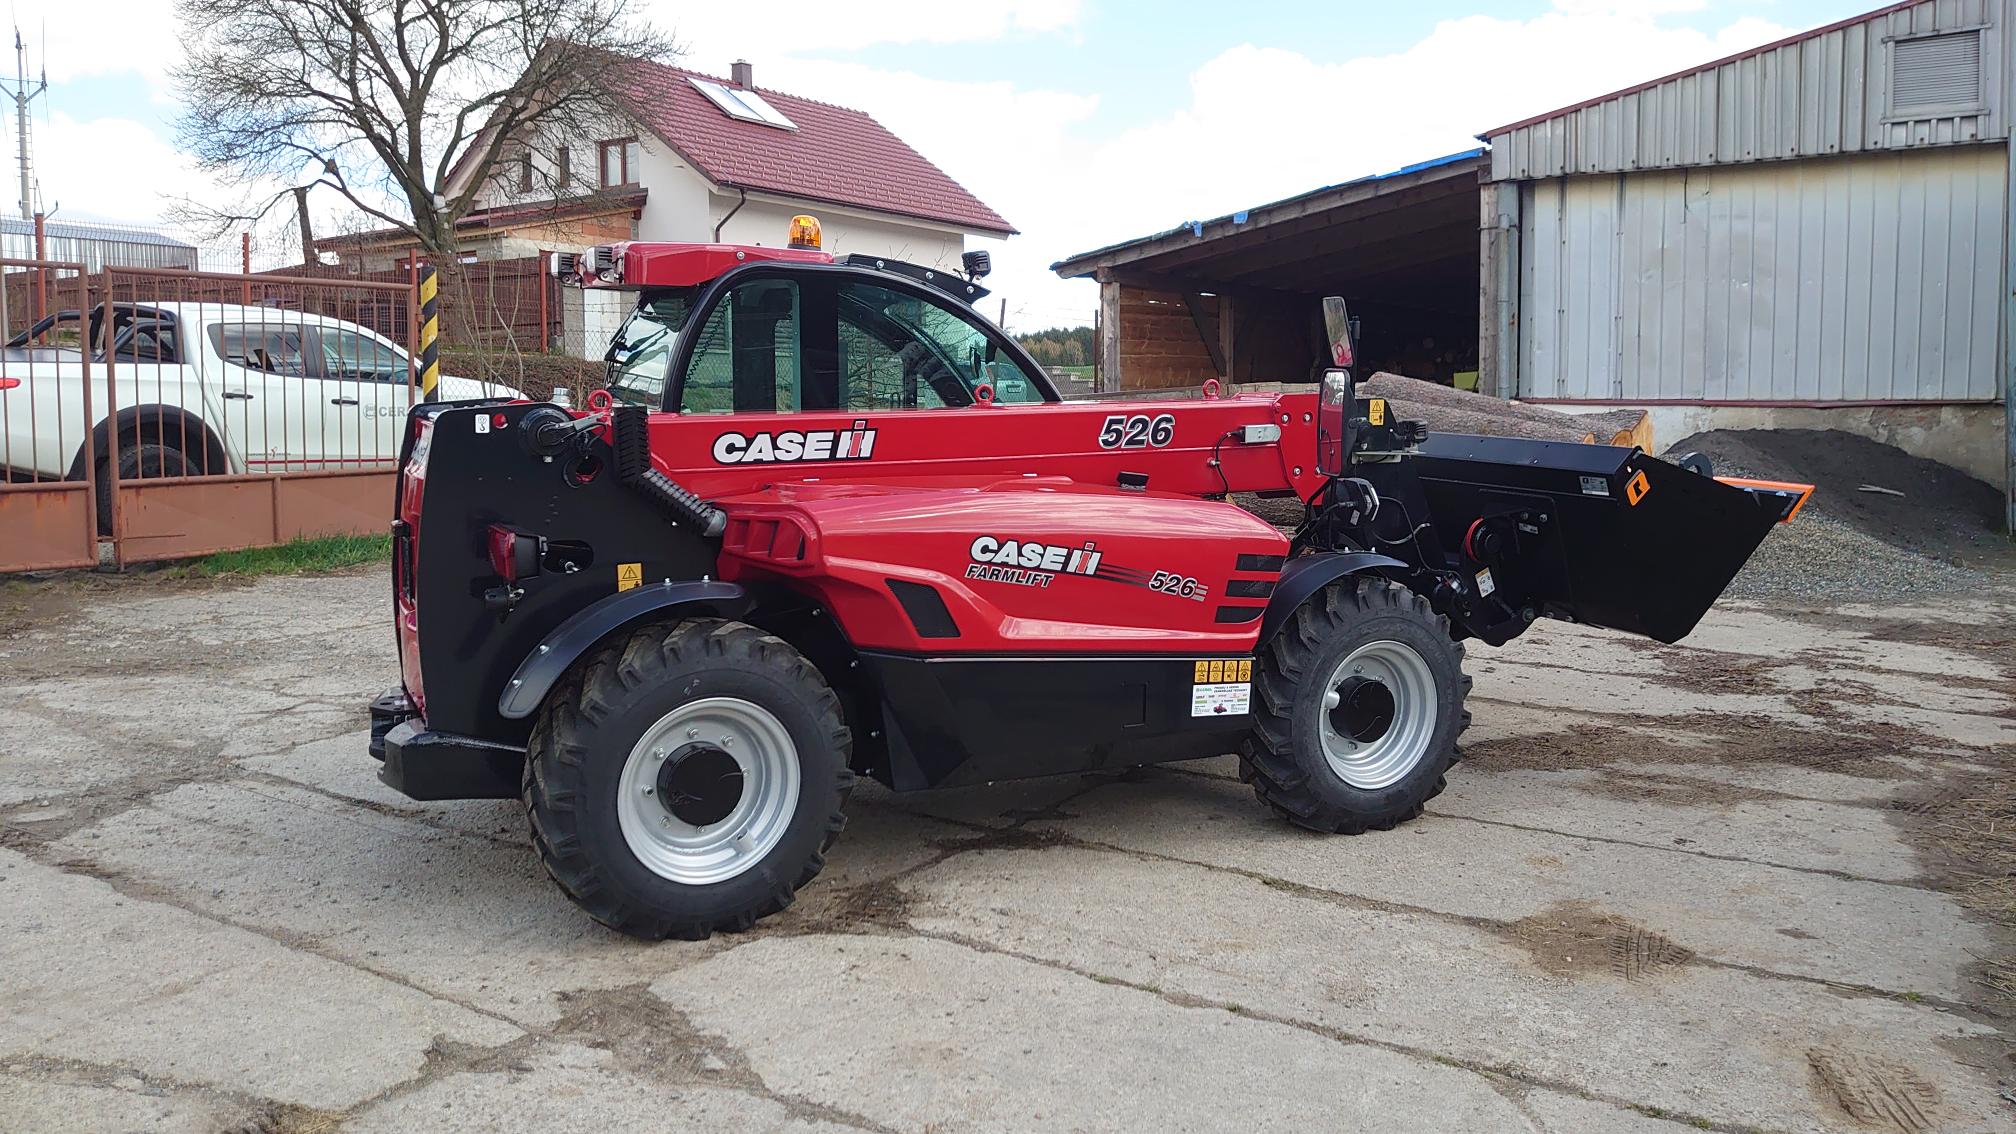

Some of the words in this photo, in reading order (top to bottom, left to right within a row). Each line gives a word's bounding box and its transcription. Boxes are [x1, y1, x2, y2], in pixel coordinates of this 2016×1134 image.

[378, 406, 408, 417] CER
[1098, 413, 1176, 449] 526
[712, 431, 835, 464] CASE
[970, 536, 1069, 572] CASE
[964, 563, 1055, 588] FARMLIFT
[1148, 569, 1198, 599] 526
